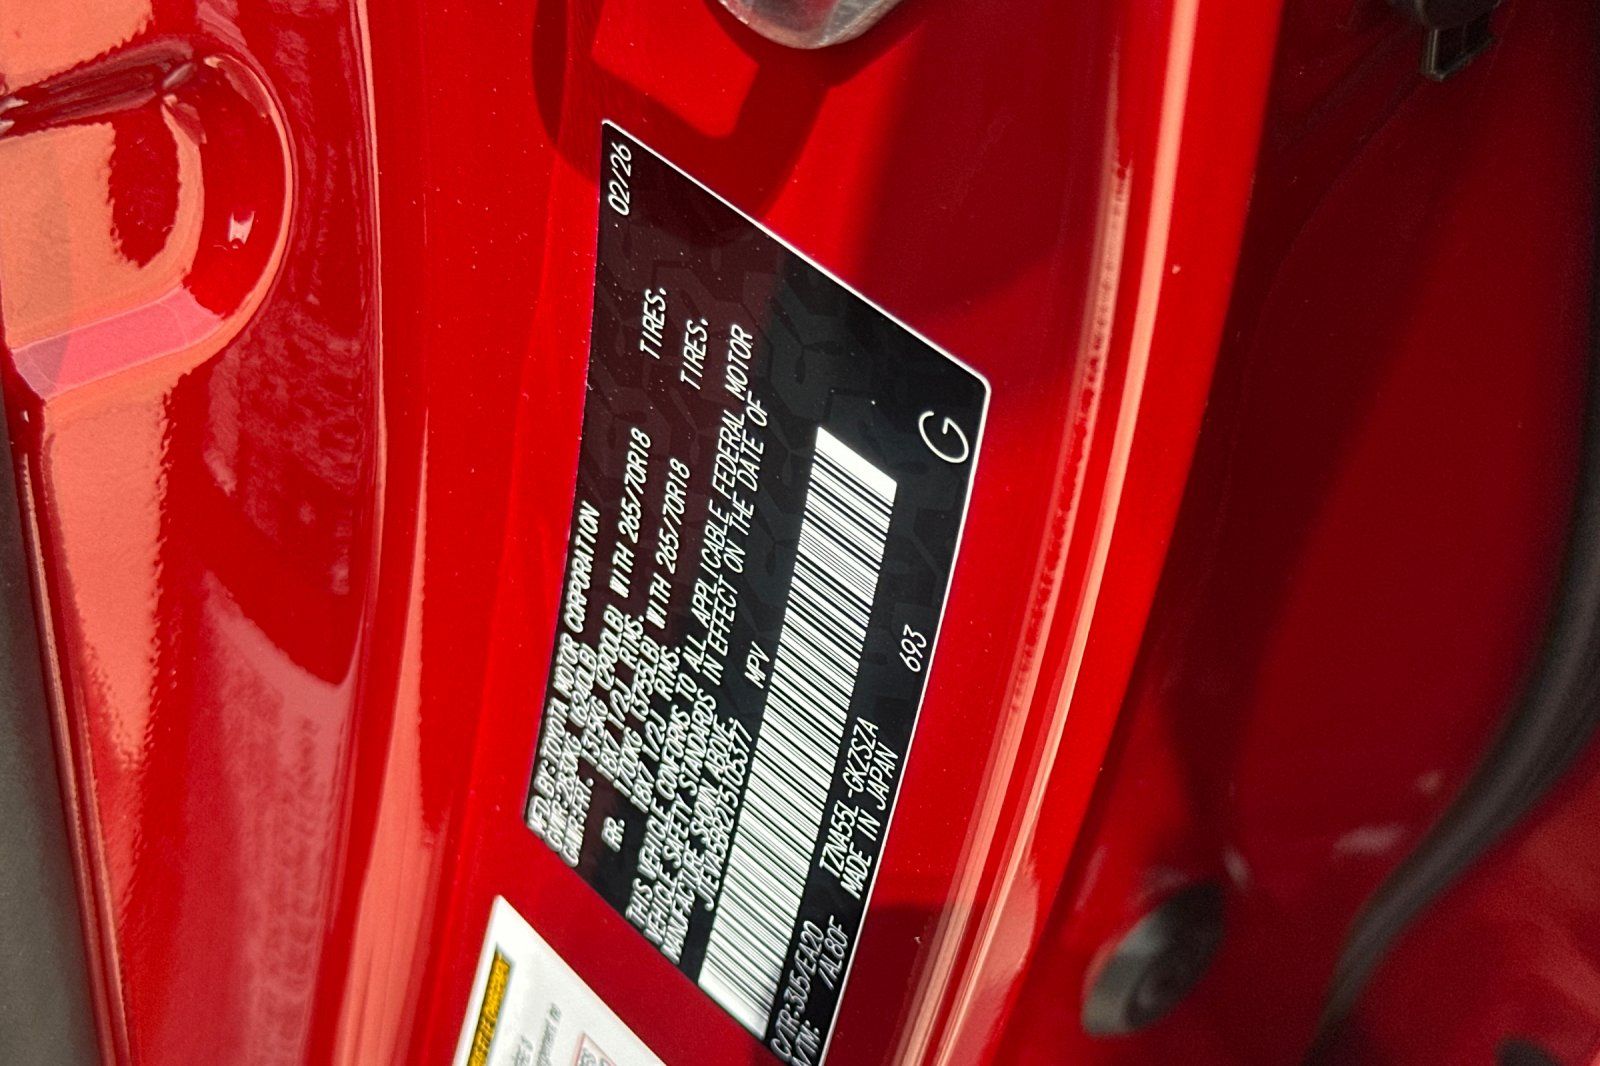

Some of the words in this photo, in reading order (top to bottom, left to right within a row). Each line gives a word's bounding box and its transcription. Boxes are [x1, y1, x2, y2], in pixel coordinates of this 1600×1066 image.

[608, 142, 631, 215] 02/26
[640, 287, 666, 359] TIRES.
[680, 318, 708, 390] TIRES.
[724, 324, 753, 401] MOTOR
[744, 390, 767, 426] OF
[918, 410, 969, 463] G
[618, 427, 651, 543] 265/70R18
[712, 409, 745, 499] FEDERAL
[736, 429, 764, 491] DATE
[655, 458, 690, 574] 265/70R18
[728, 491, 754, 535] THE
[564, 500, 600, 633] CORPORATION
[609, 541, 634, 598] WITH
[691, 499, 729, 631] APPLICABLE
[723, 539, 745, 573] ON
[646, 572, 671, 629] WITH
[707, 574, 738, 656] EFFECT
[553, 632, 580, 701] MOTOR
[596, 604, 624, 696] (2900LB)
[619, 614, 644, 671] RIMS.
[654, 645, 680, 701] RIMS.
[683, 634, 707, 673] ALL
[702, 653, 723, 685] IN
[744, 641, 770, 689] MPV
[899, 624, 927, 672] 693
[569, 643, 598, 733] (6240LB)
[628, 635, 660, 726] (3755LB)
[675, 673, 697, 708] TO
[580, 695, 608, 770] 1315KG
[613, 727, 642, 800] 1700KG
[656, 704, 690, 806] CONFORMS
[678, 688, 716, 796] STANDARDS
[704, 714, 736, 781] ABOVE.
[866, 742, 898, 810] JAPAN
[601, 817, 625, 850] RR.
[638, 797, 672, 879] VEHICLE
[663, 793, 692, 873] SAFETY
[690, 778, 720, 847] SHOWN
[697, 719, 752, 911] JTEVA5BR2T5105377
[856, 809, 880, 841] IN
[626, 878, 654, 926] THIS
[662, 837, 706, 962] MANUFACTURE
[840, 841, 872, 899] MADE
[645, 864, 678, 949] VEHICLE
